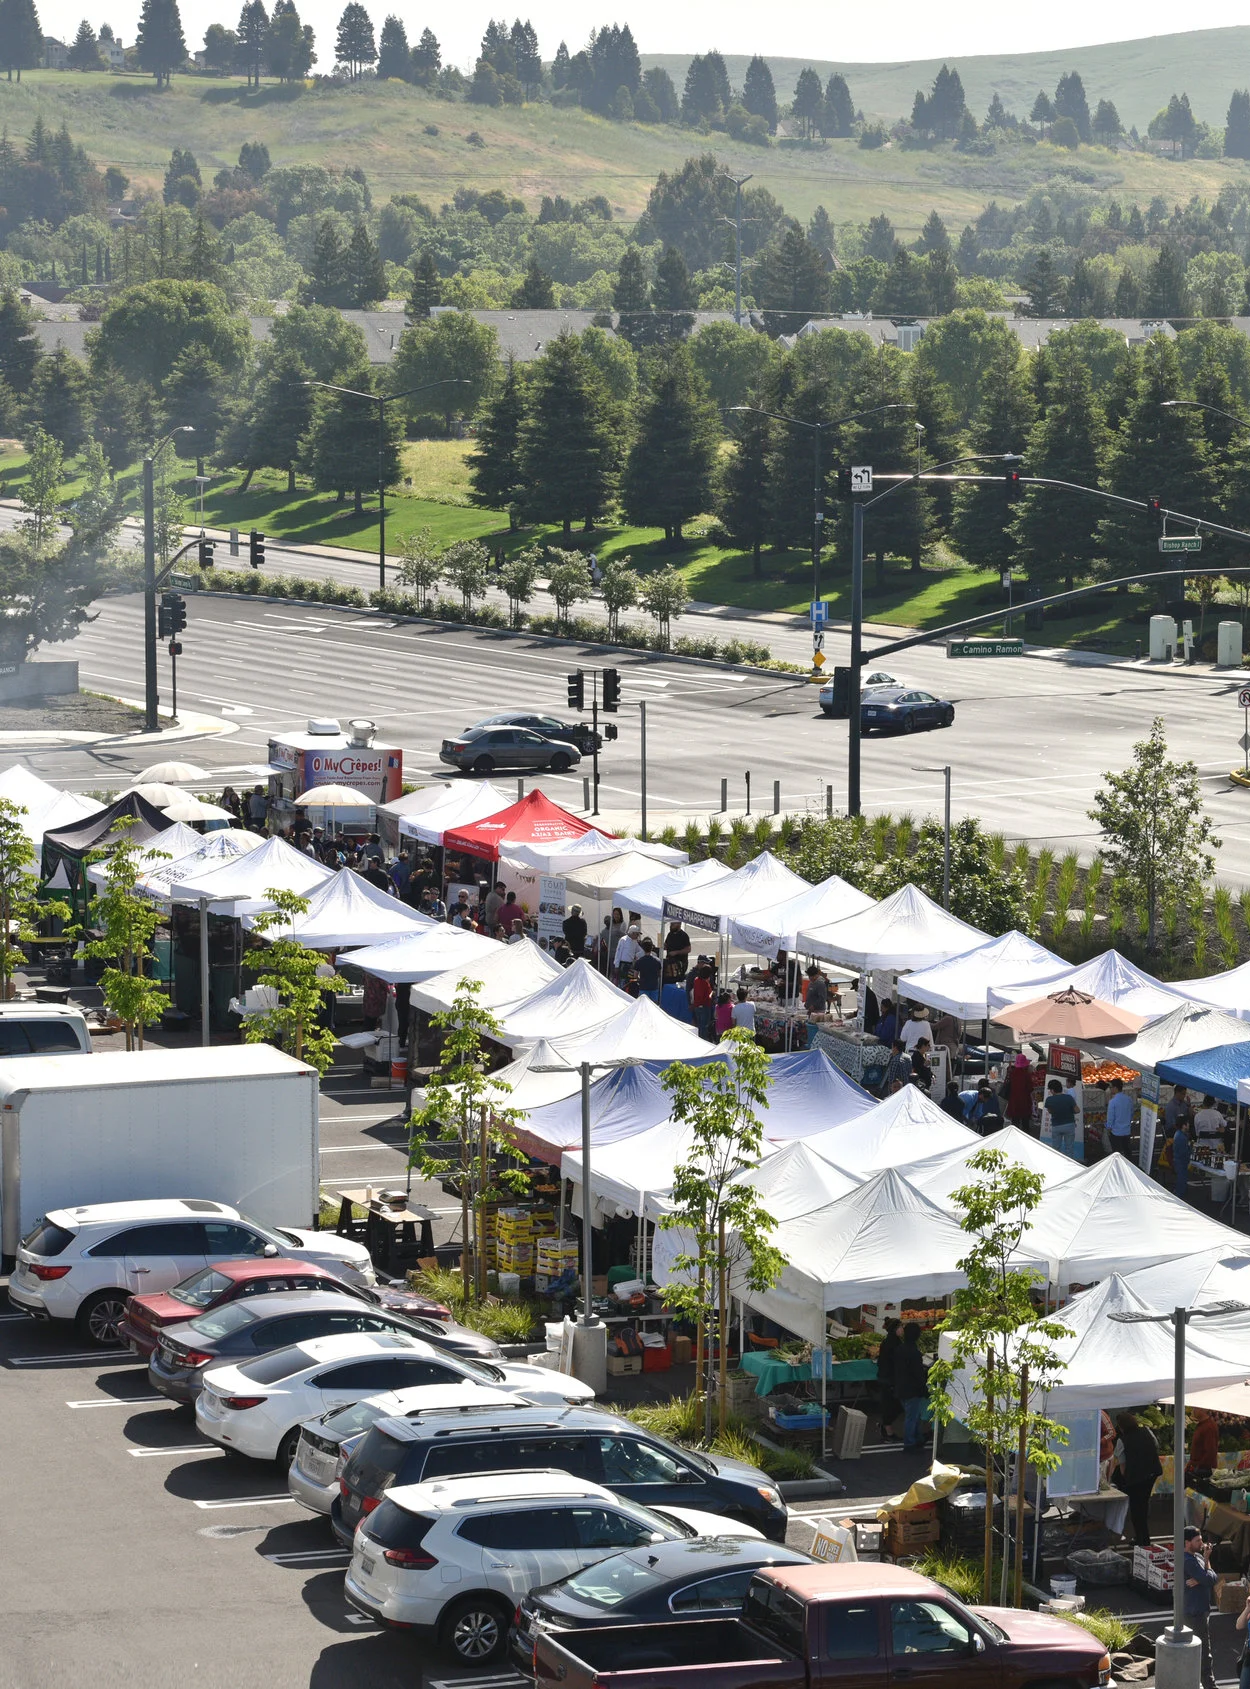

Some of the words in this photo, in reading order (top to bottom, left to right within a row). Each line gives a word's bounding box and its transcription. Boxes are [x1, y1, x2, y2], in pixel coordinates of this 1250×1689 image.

[1163, 542, 1180, 550] Bishop
[812, 602, 826, 620] H
[962, 646, 992, 654] Camino
[995, 645, 1022, 654] Ramon
[313, 757, 322, 772] O
[666, 904, 682, 920] KNIFE
[683, 910, 718, 930] SHARPENING
[815, 1537, 828, 1557] NO
